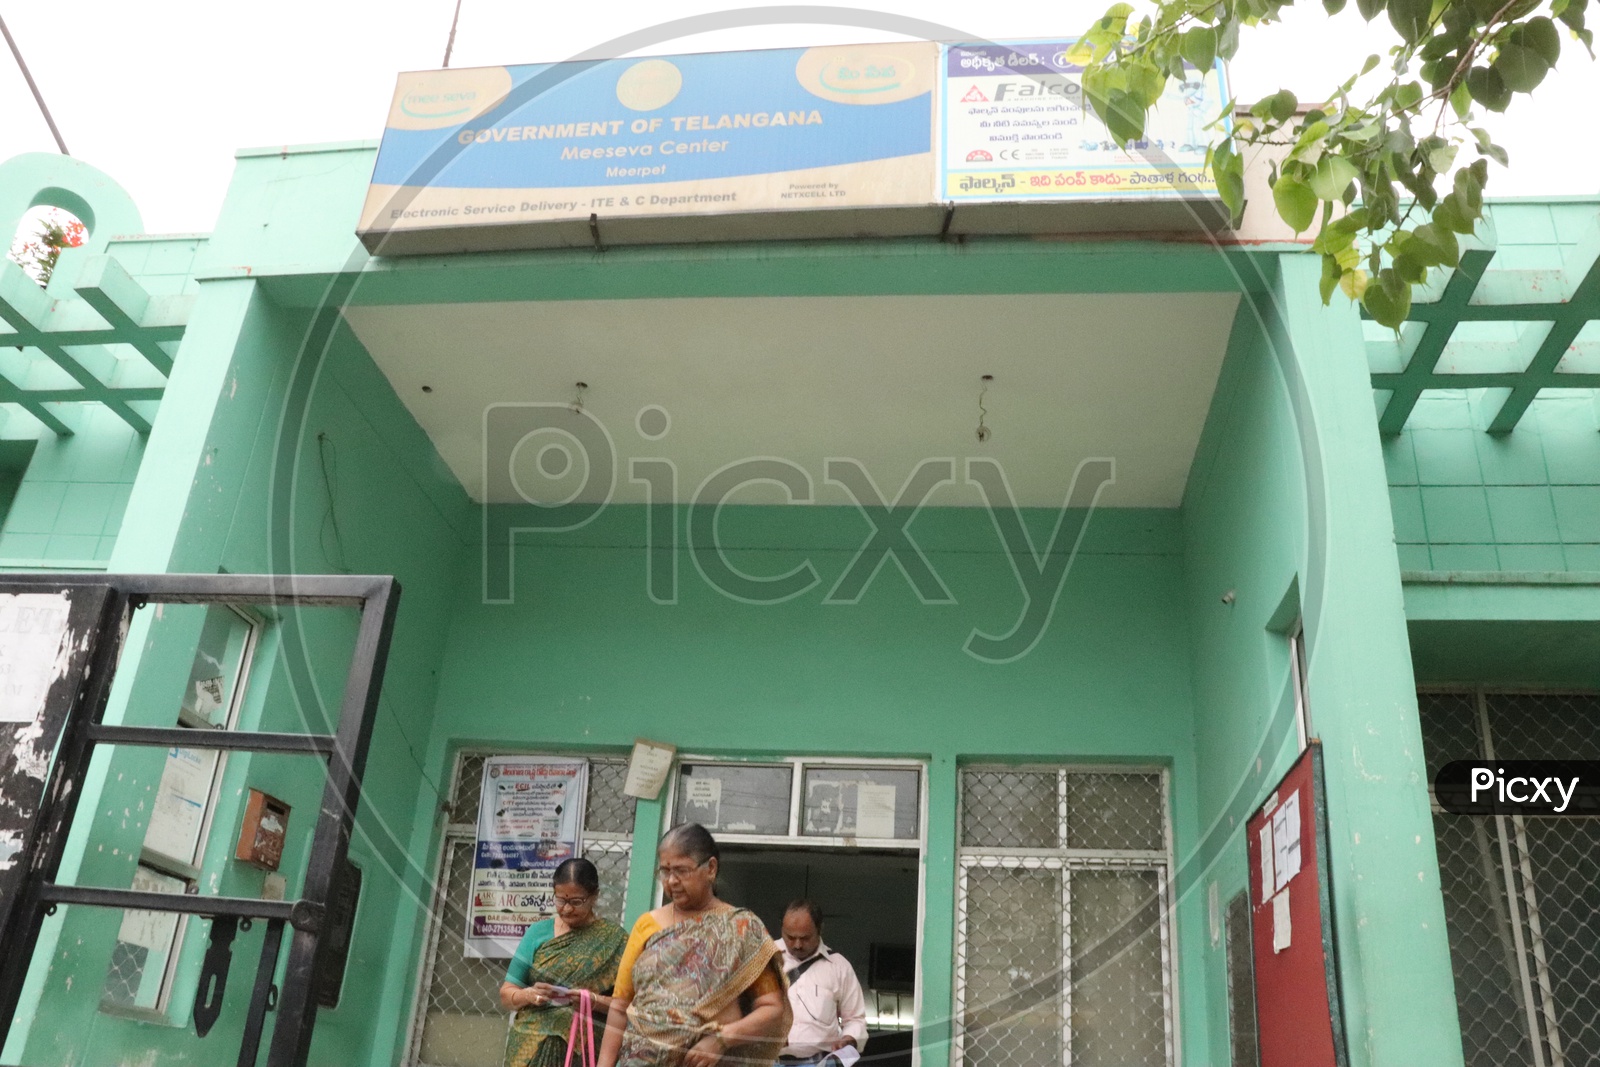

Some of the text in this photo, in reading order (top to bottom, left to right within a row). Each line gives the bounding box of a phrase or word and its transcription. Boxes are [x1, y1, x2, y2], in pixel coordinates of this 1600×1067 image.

[994, 81, 1083, 102] Falco
[457, 110, 823, 146] GOVERNMENT OF TELANGANA
[560, 139, 729, 161] Meeseva Center
[606, 164, 666, 179] Meerpet
[781, 190, 846, 199] NETXCELL LTD
[789, 181, 839, 190] Powered by
[390, 206, 460, 220] Electronic
[464, 203, 516, 215] Service
[520, 200, 578, 213] Delivery
[591, 197, 614, 208] ITE
[620, 197, 630, 207] &
[635, 196, 645, 206] C
[650, 192, 737, 207] Department
[498, 893, 520, 907] ARC
